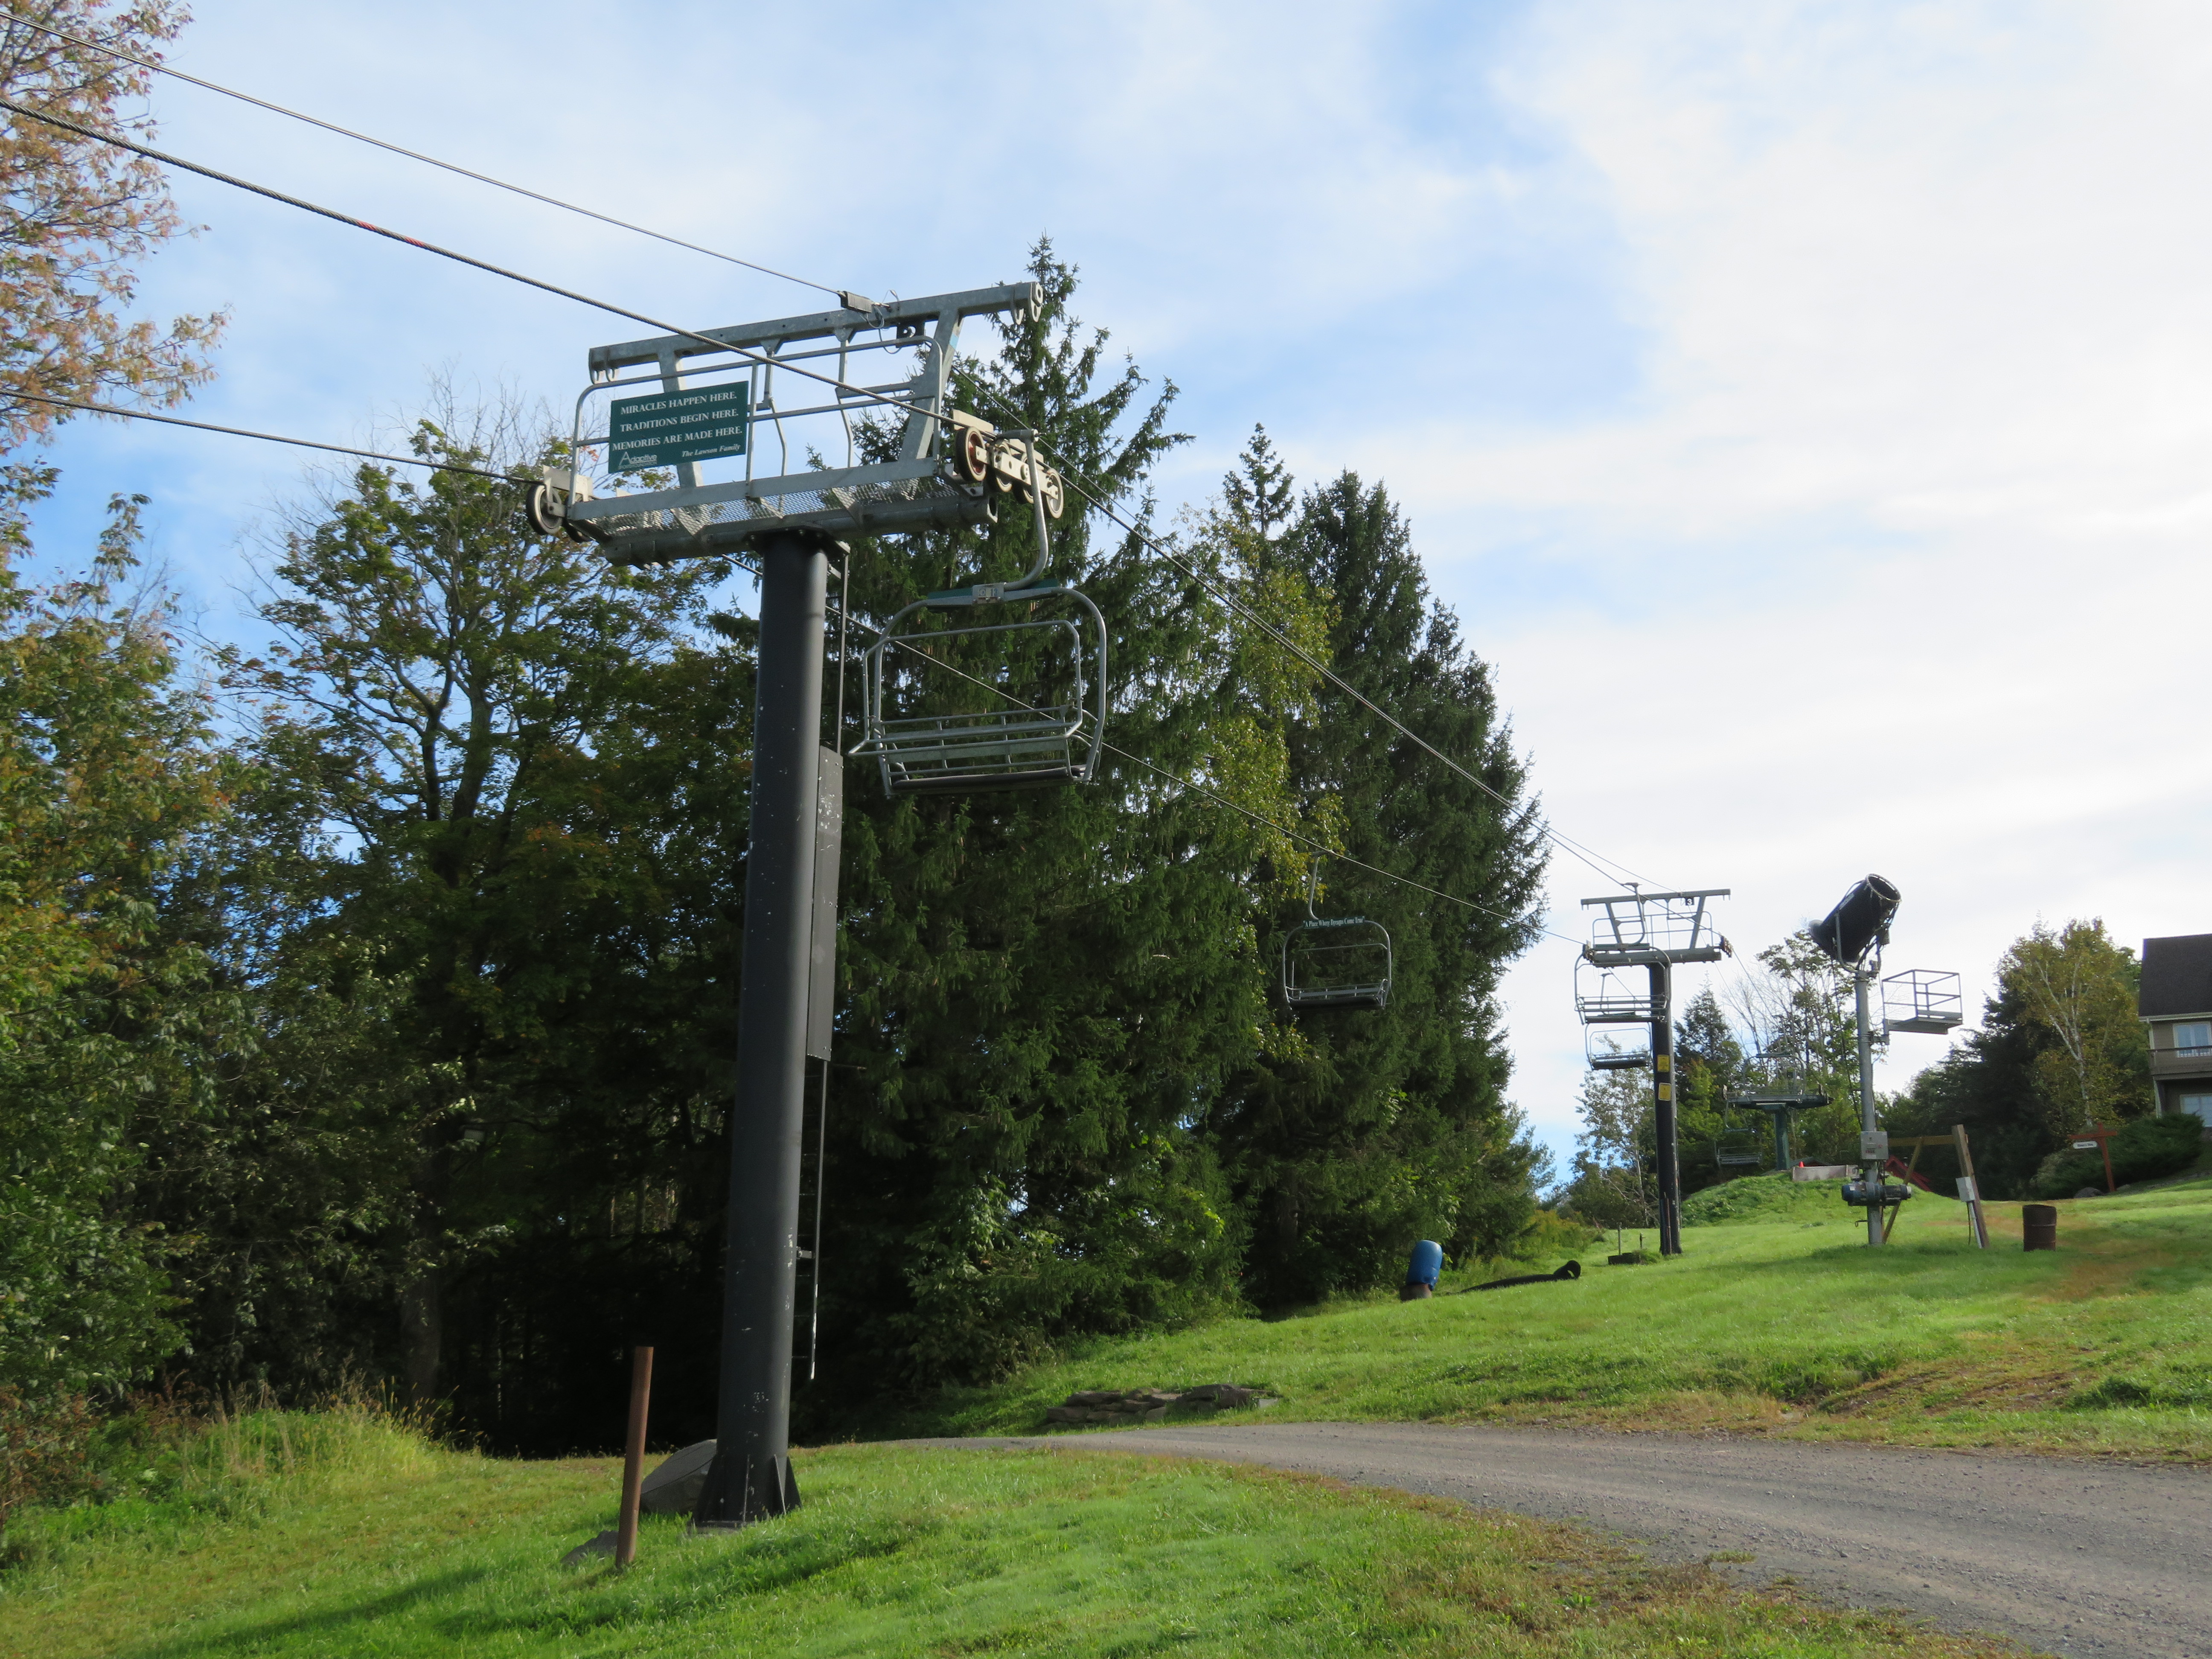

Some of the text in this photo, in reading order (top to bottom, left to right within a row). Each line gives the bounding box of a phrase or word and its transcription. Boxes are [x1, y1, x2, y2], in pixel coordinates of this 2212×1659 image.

[621, 391, 737, 415] MIRACLES HAPPEN HERE.
[620, 408, 739, 432] TRADITIONS BEGIN HERE.
[612, 426, 742, 451] MEMORIES ARE MADE HERE.
[719, 444, 741, 452] Family
[619, 451, 658, 466] Adaptive
